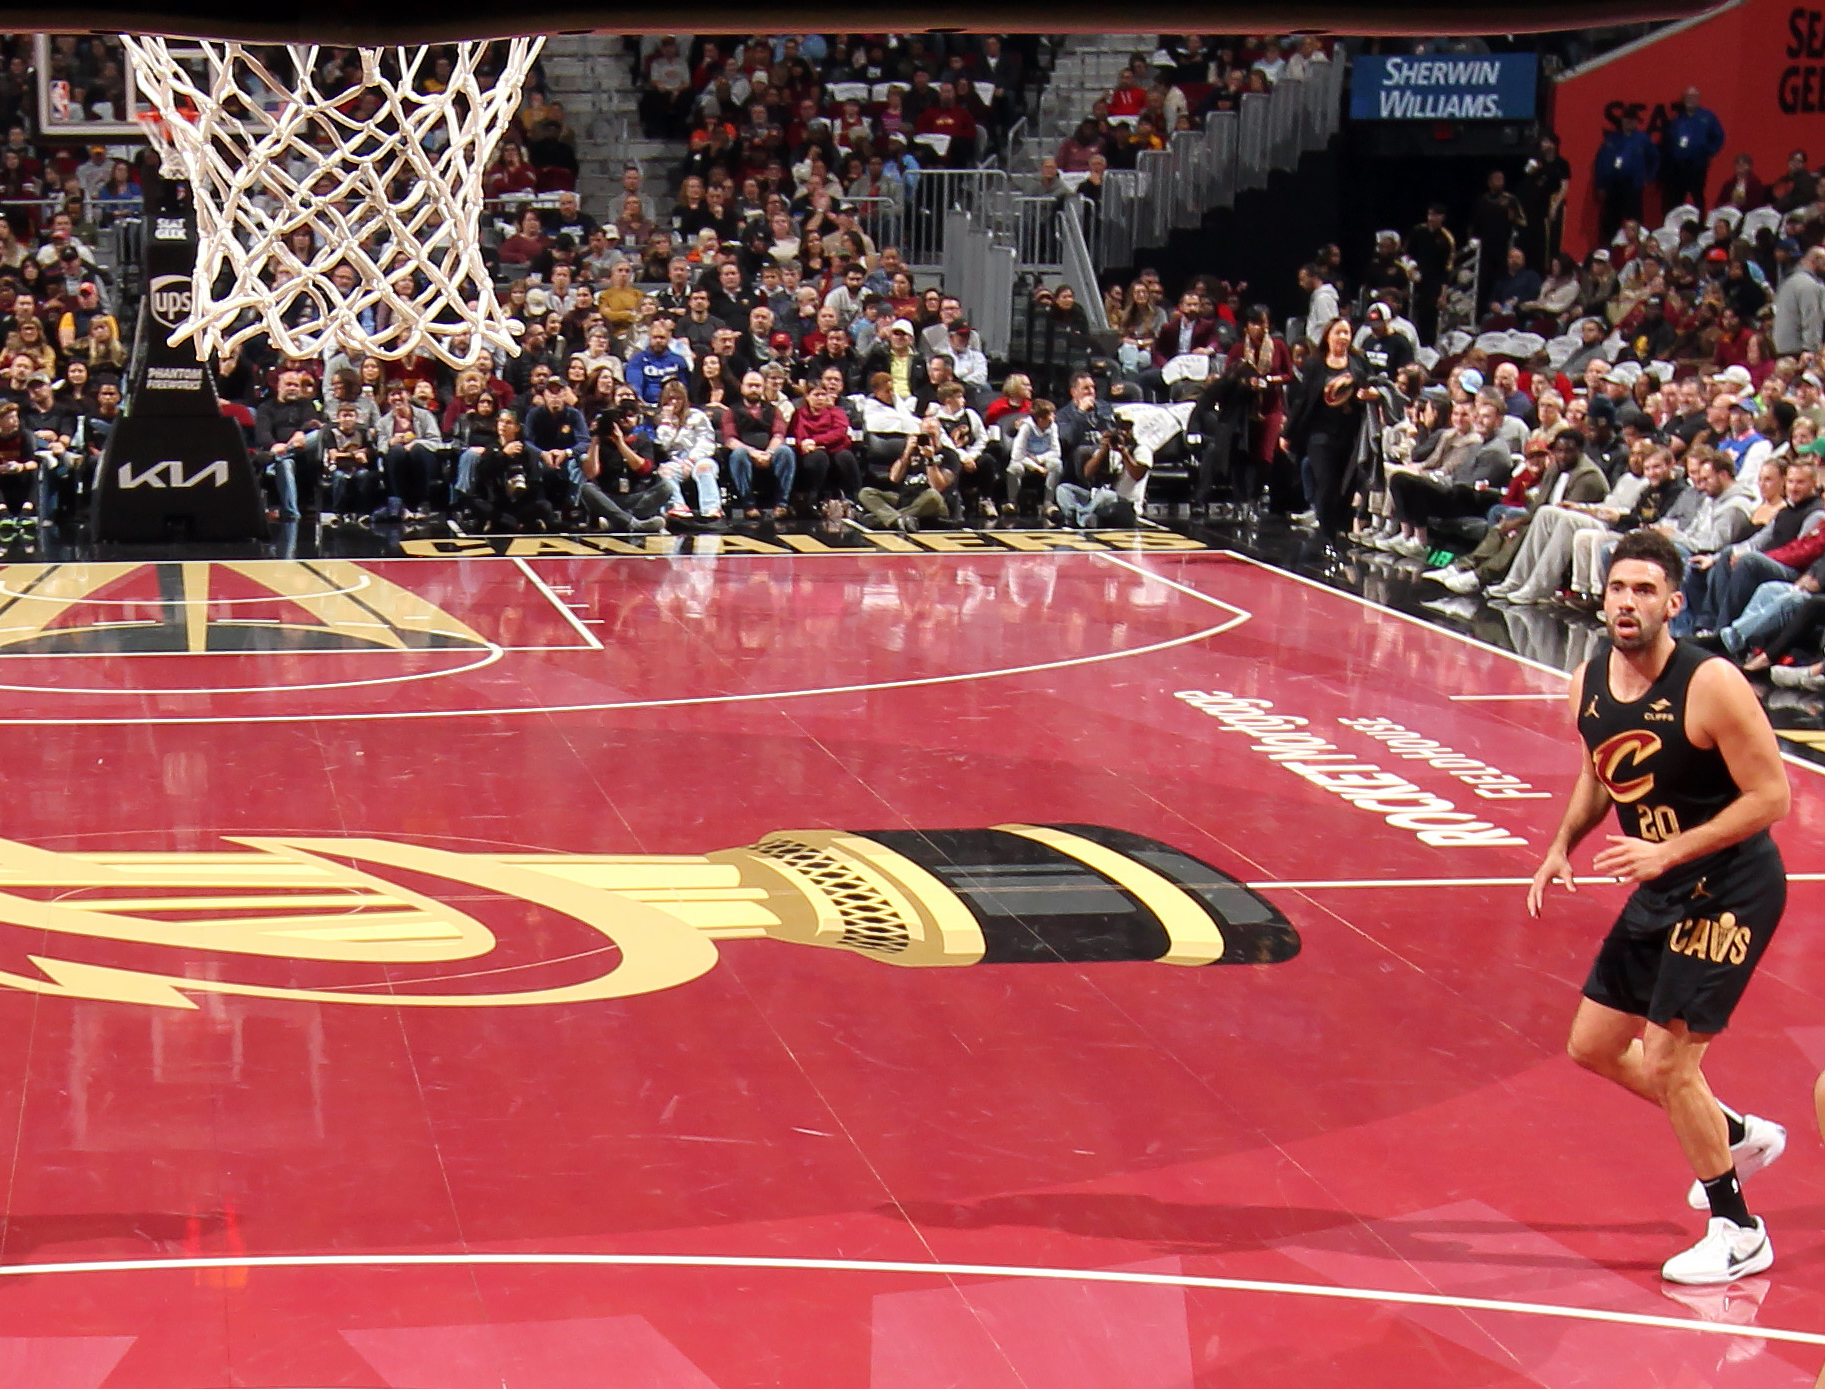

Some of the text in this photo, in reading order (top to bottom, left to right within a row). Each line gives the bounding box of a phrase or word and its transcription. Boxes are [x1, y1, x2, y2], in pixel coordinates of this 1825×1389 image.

[1382, 57, 1501, 87] SHERWIN
[1379, 90, 1500, 119] WILLIAMS
[155, 292, 191, 319] ups
[118, 460, 229, 489] KIA
[399, 531, 1208, 557] CAVALIERS
[1336, 716, 1553, 800] FIELDHOUSE
[1636, 804, 1681, 841] 20
[1667, 913, 1751, 965] CAVS
